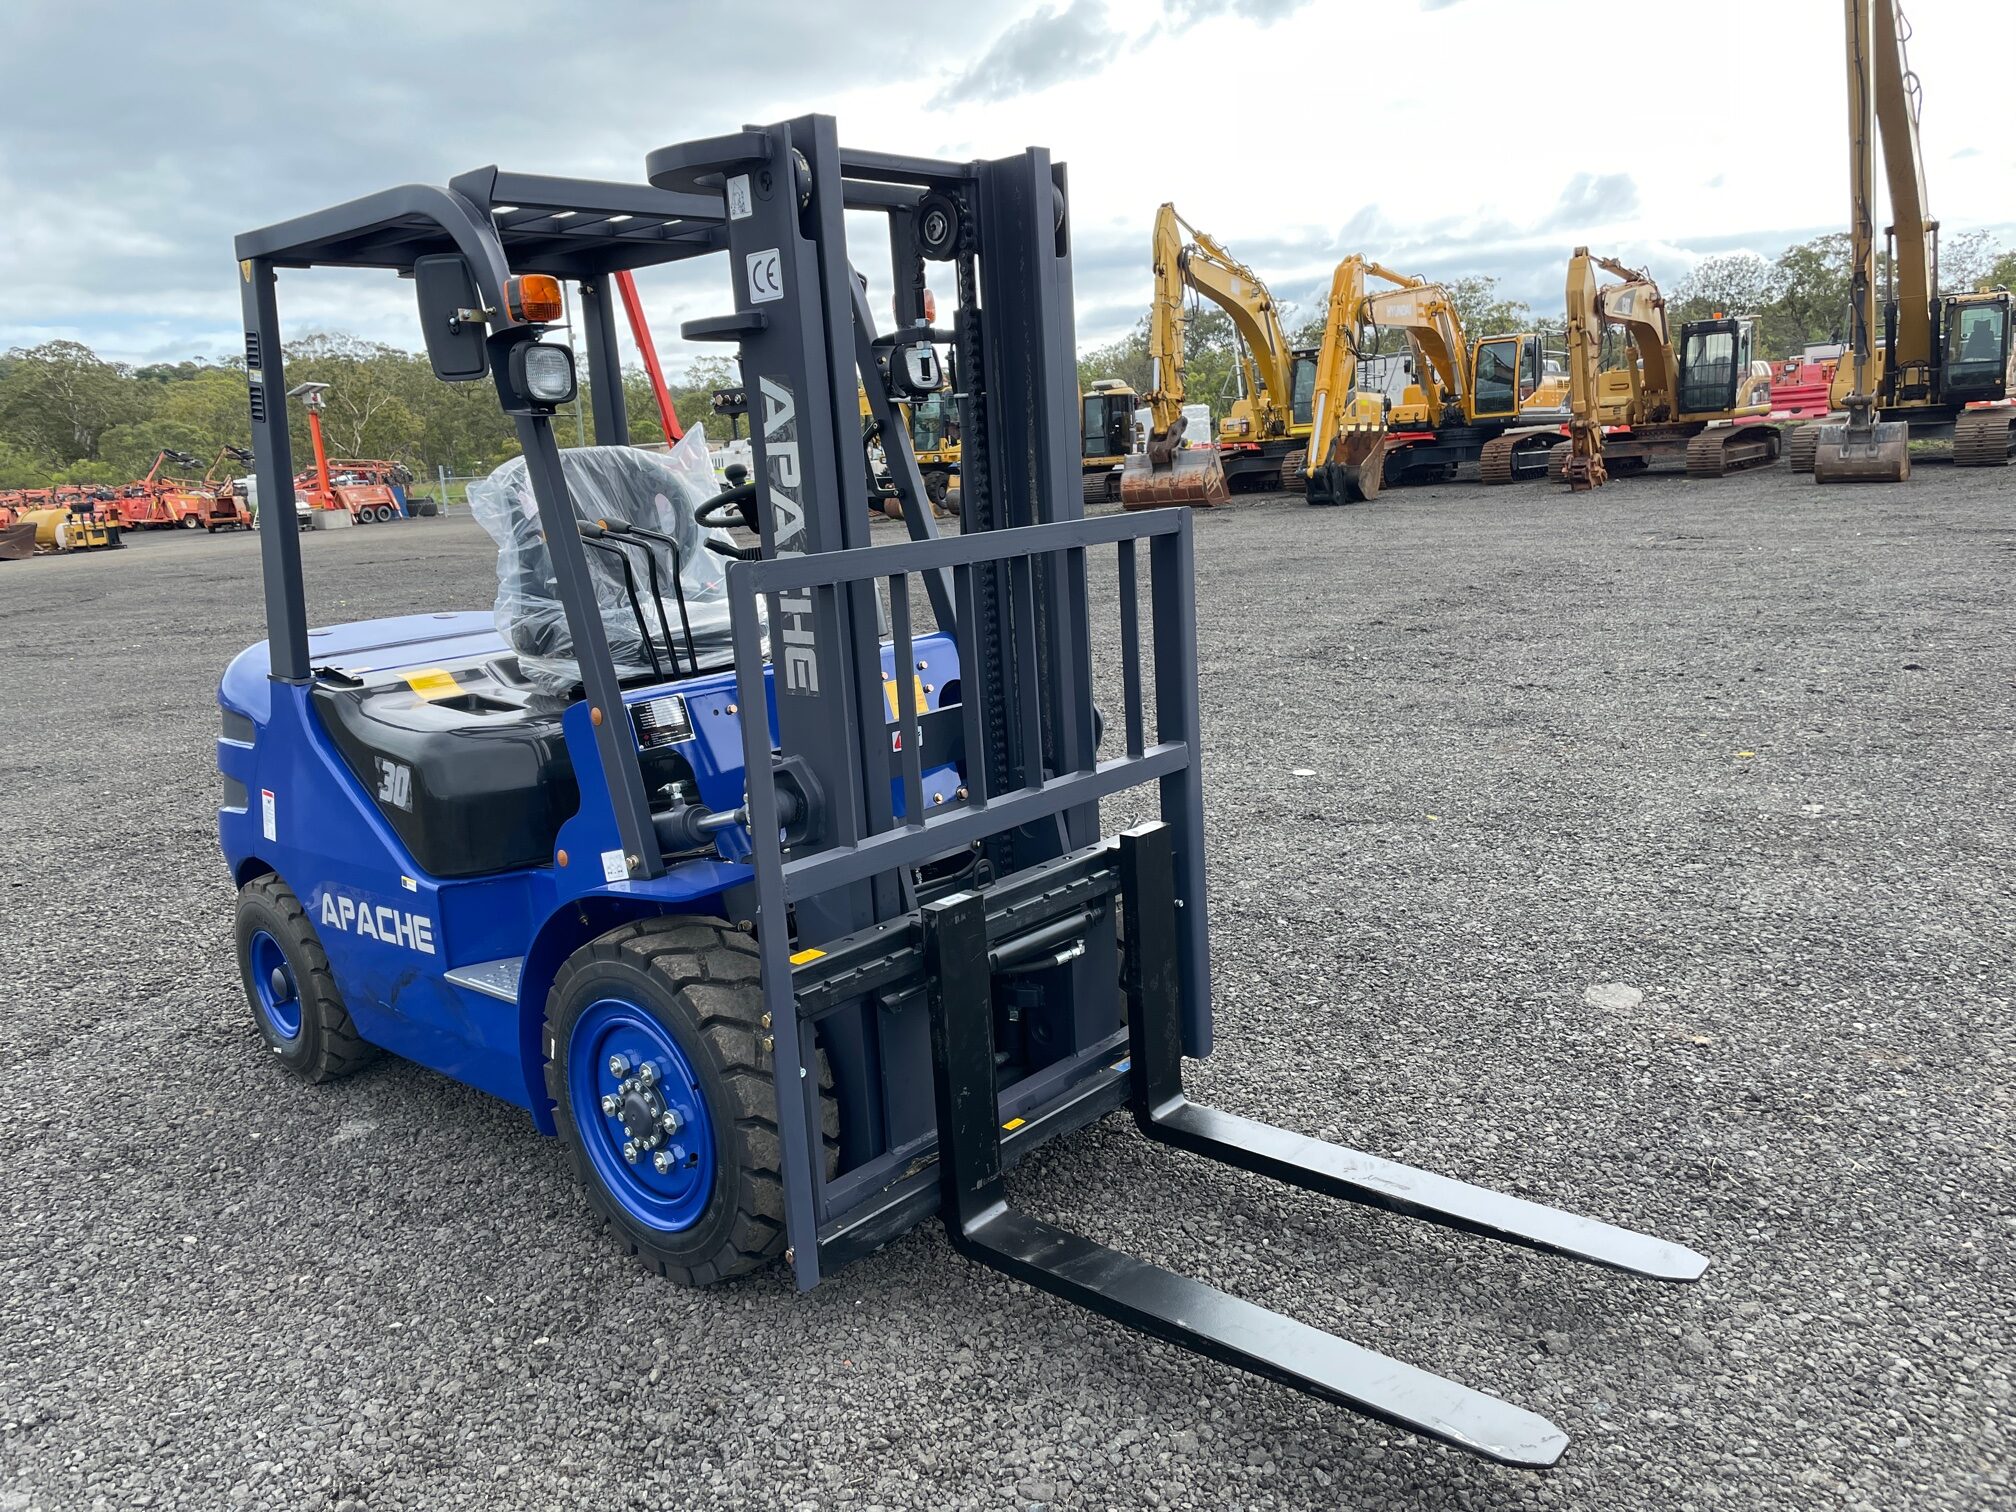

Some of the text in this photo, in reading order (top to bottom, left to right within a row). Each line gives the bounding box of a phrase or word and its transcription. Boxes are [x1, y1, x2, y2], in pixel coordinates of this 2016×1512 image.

[753, 257, 778, 293] CE
[379, 761, 410, 807] 30
[321, 892, 435, 955] APACHE
